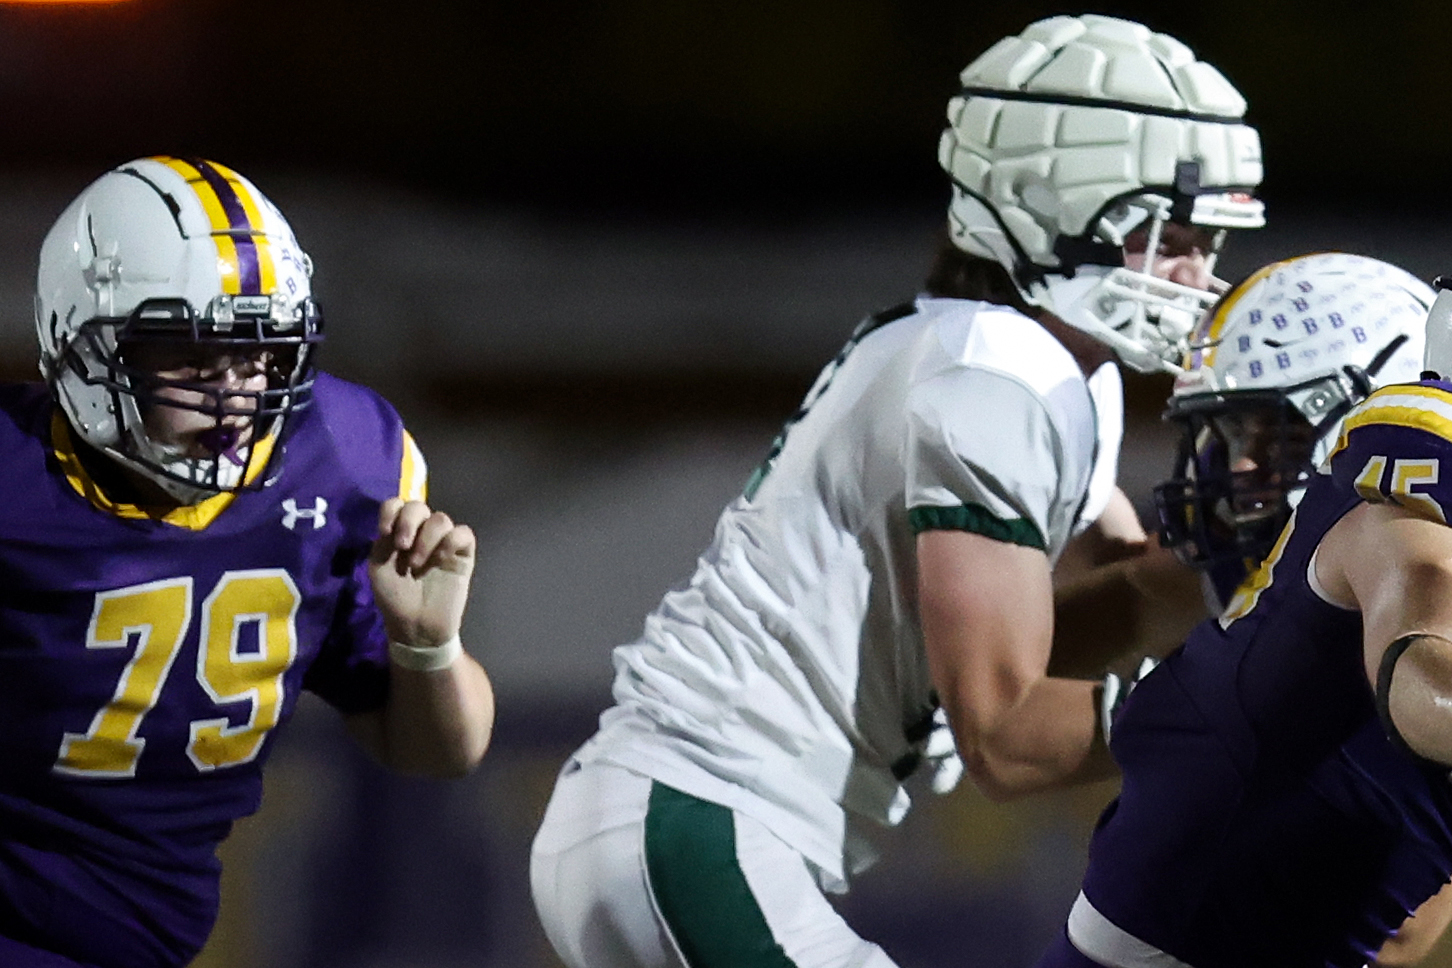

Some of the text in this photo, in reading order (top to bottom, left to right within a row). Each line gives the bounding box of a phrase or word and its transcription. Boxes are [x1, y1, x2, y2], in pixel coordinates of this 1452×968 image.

[1271, 313, 1287, 330] B
[1302, 318, 1318, 335] B
[1327, 312, 1344, 329] B
[1351, 327, 1367, 344] B
[1275, 352, 1291, 370] B
[53, 568, 301, 779] 79
